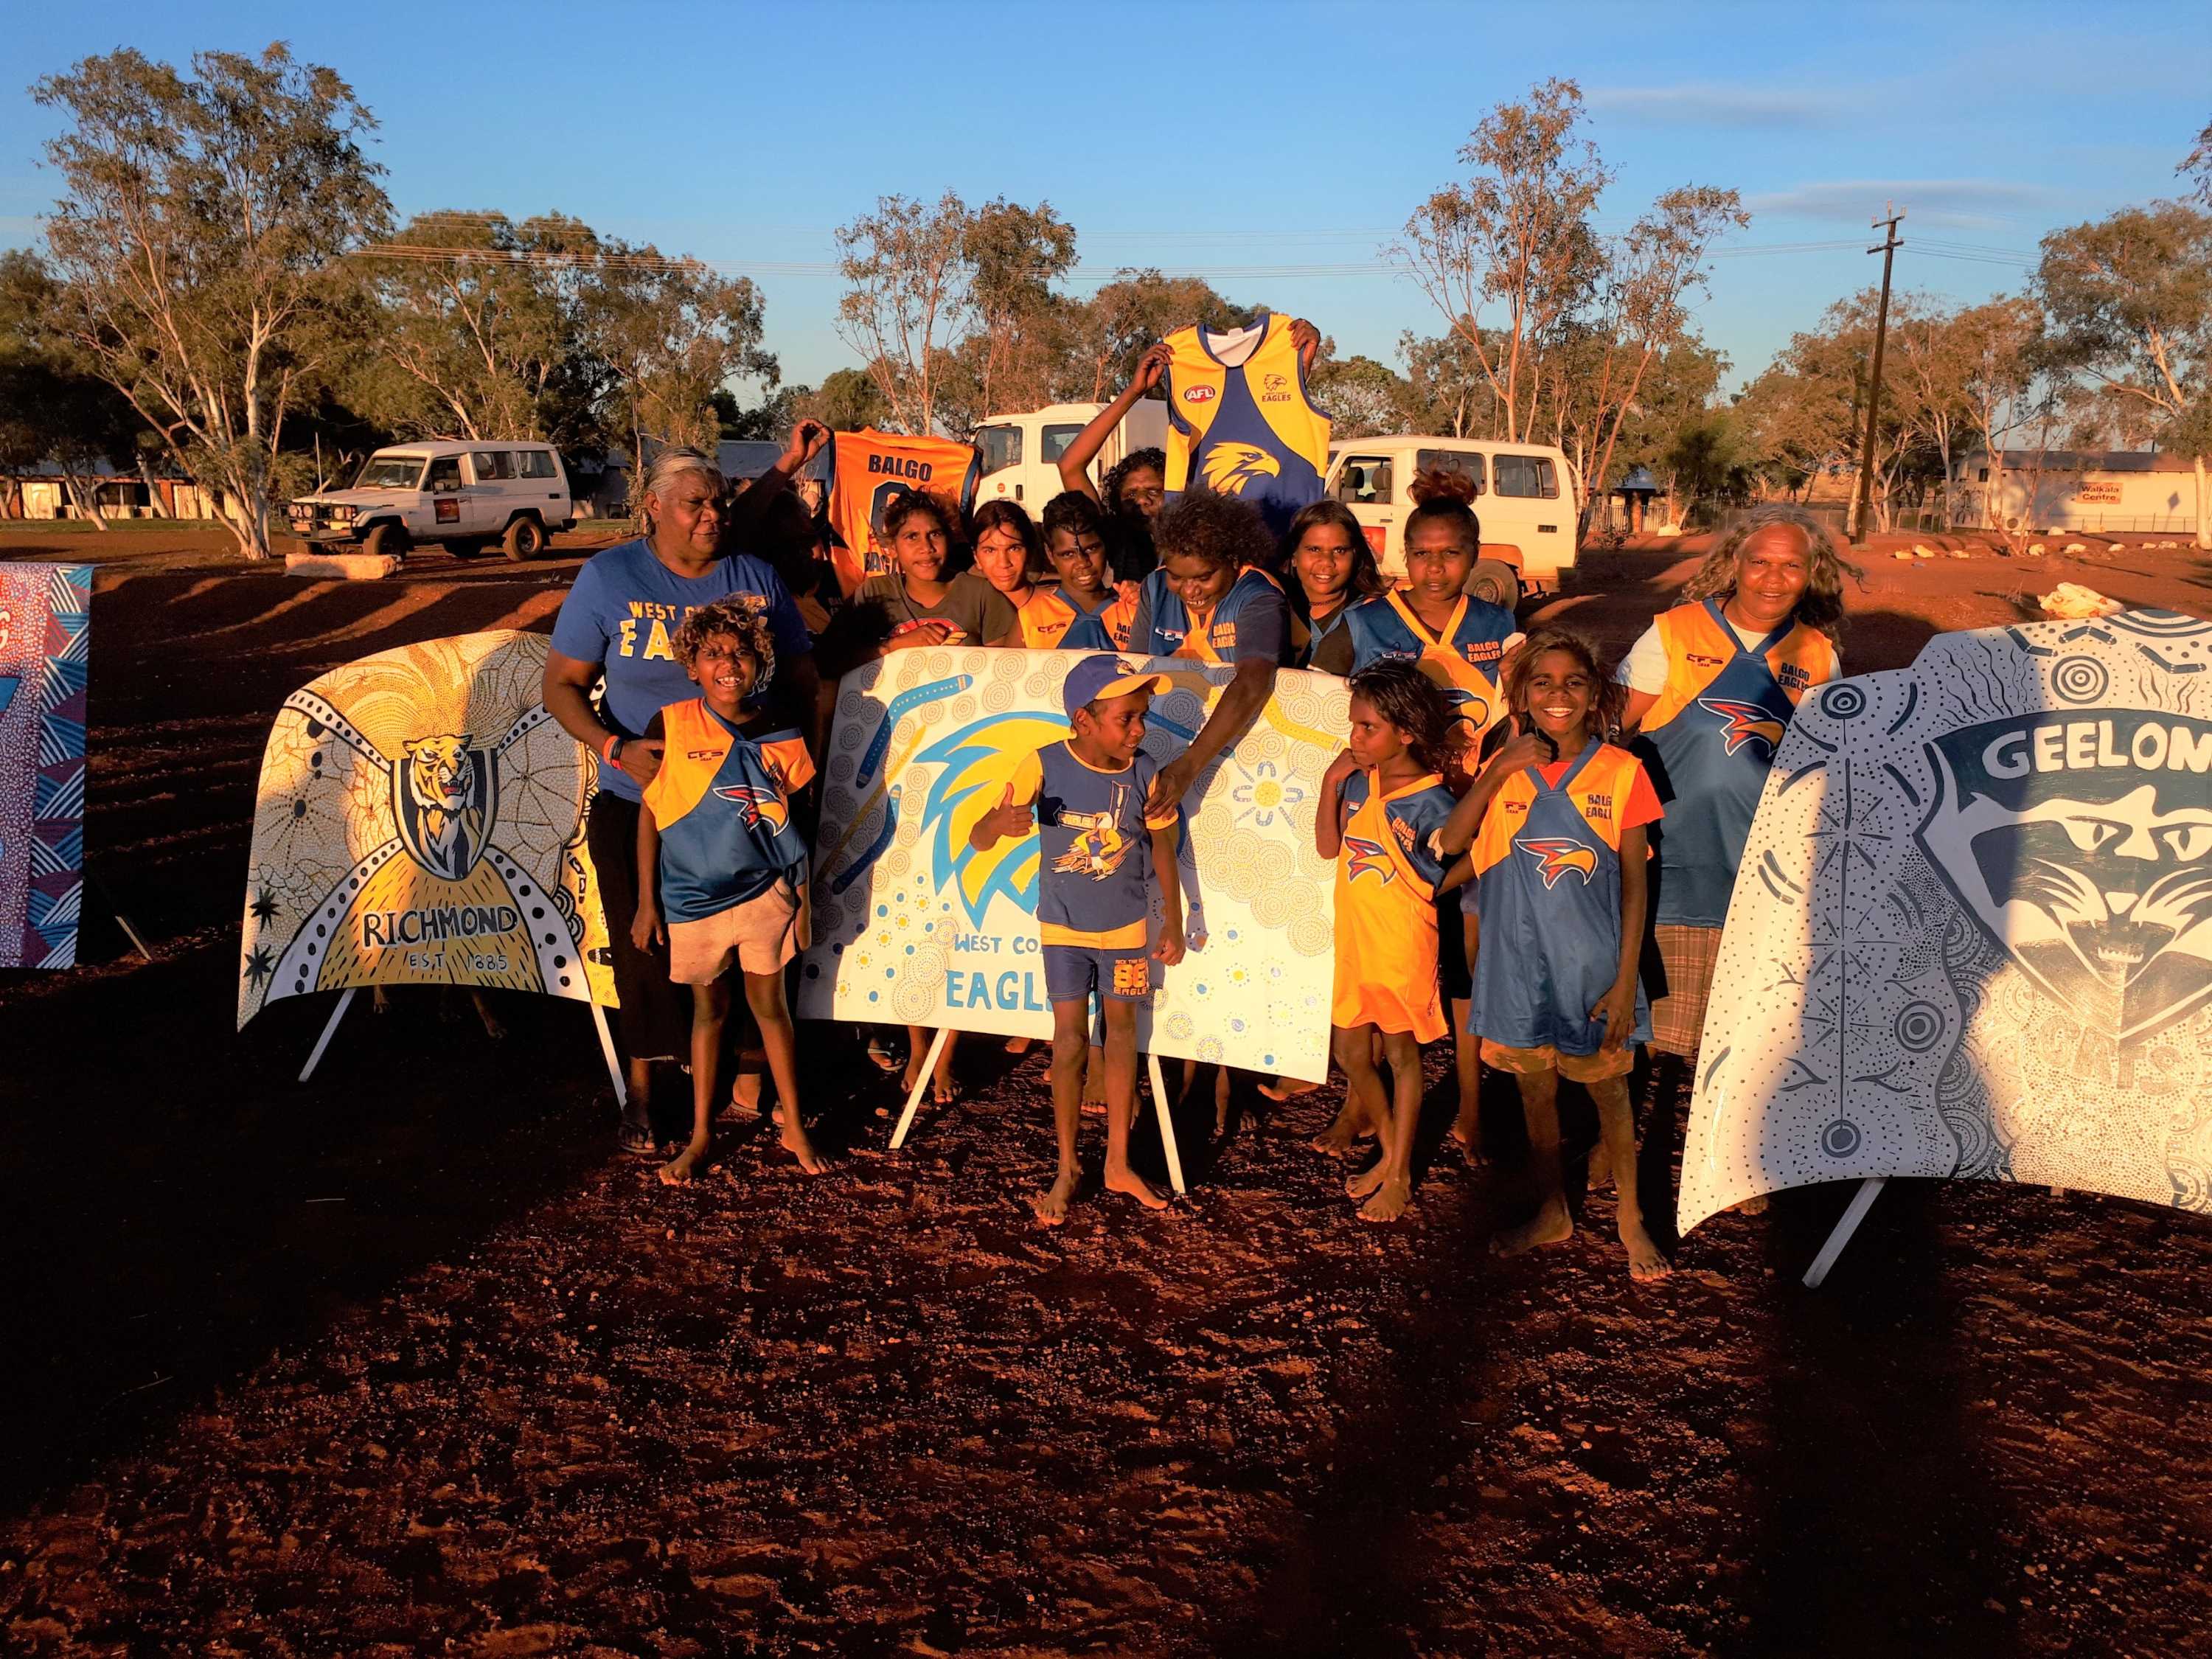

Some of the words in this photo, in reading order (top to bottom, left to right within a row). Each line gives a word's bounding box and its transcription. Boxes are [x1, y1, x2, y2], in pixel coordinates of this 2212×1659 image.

[1186, 389, 1213, 400] AFL
[868, 454, 932, 482] BALGO
[628, 602, 676, 621] WEST
[1467, 641, 1500, 652] BALGO
[1781, 662, 1810, 681] BALGO
[364, 906, 518, 947] RICHMOND
[955, 933, 1002, 953] WEST
[1012, 936, 1043, 954] CO
[409, 954, 443, 967] EST
[946, 970, 1099, 1015] EAGL
